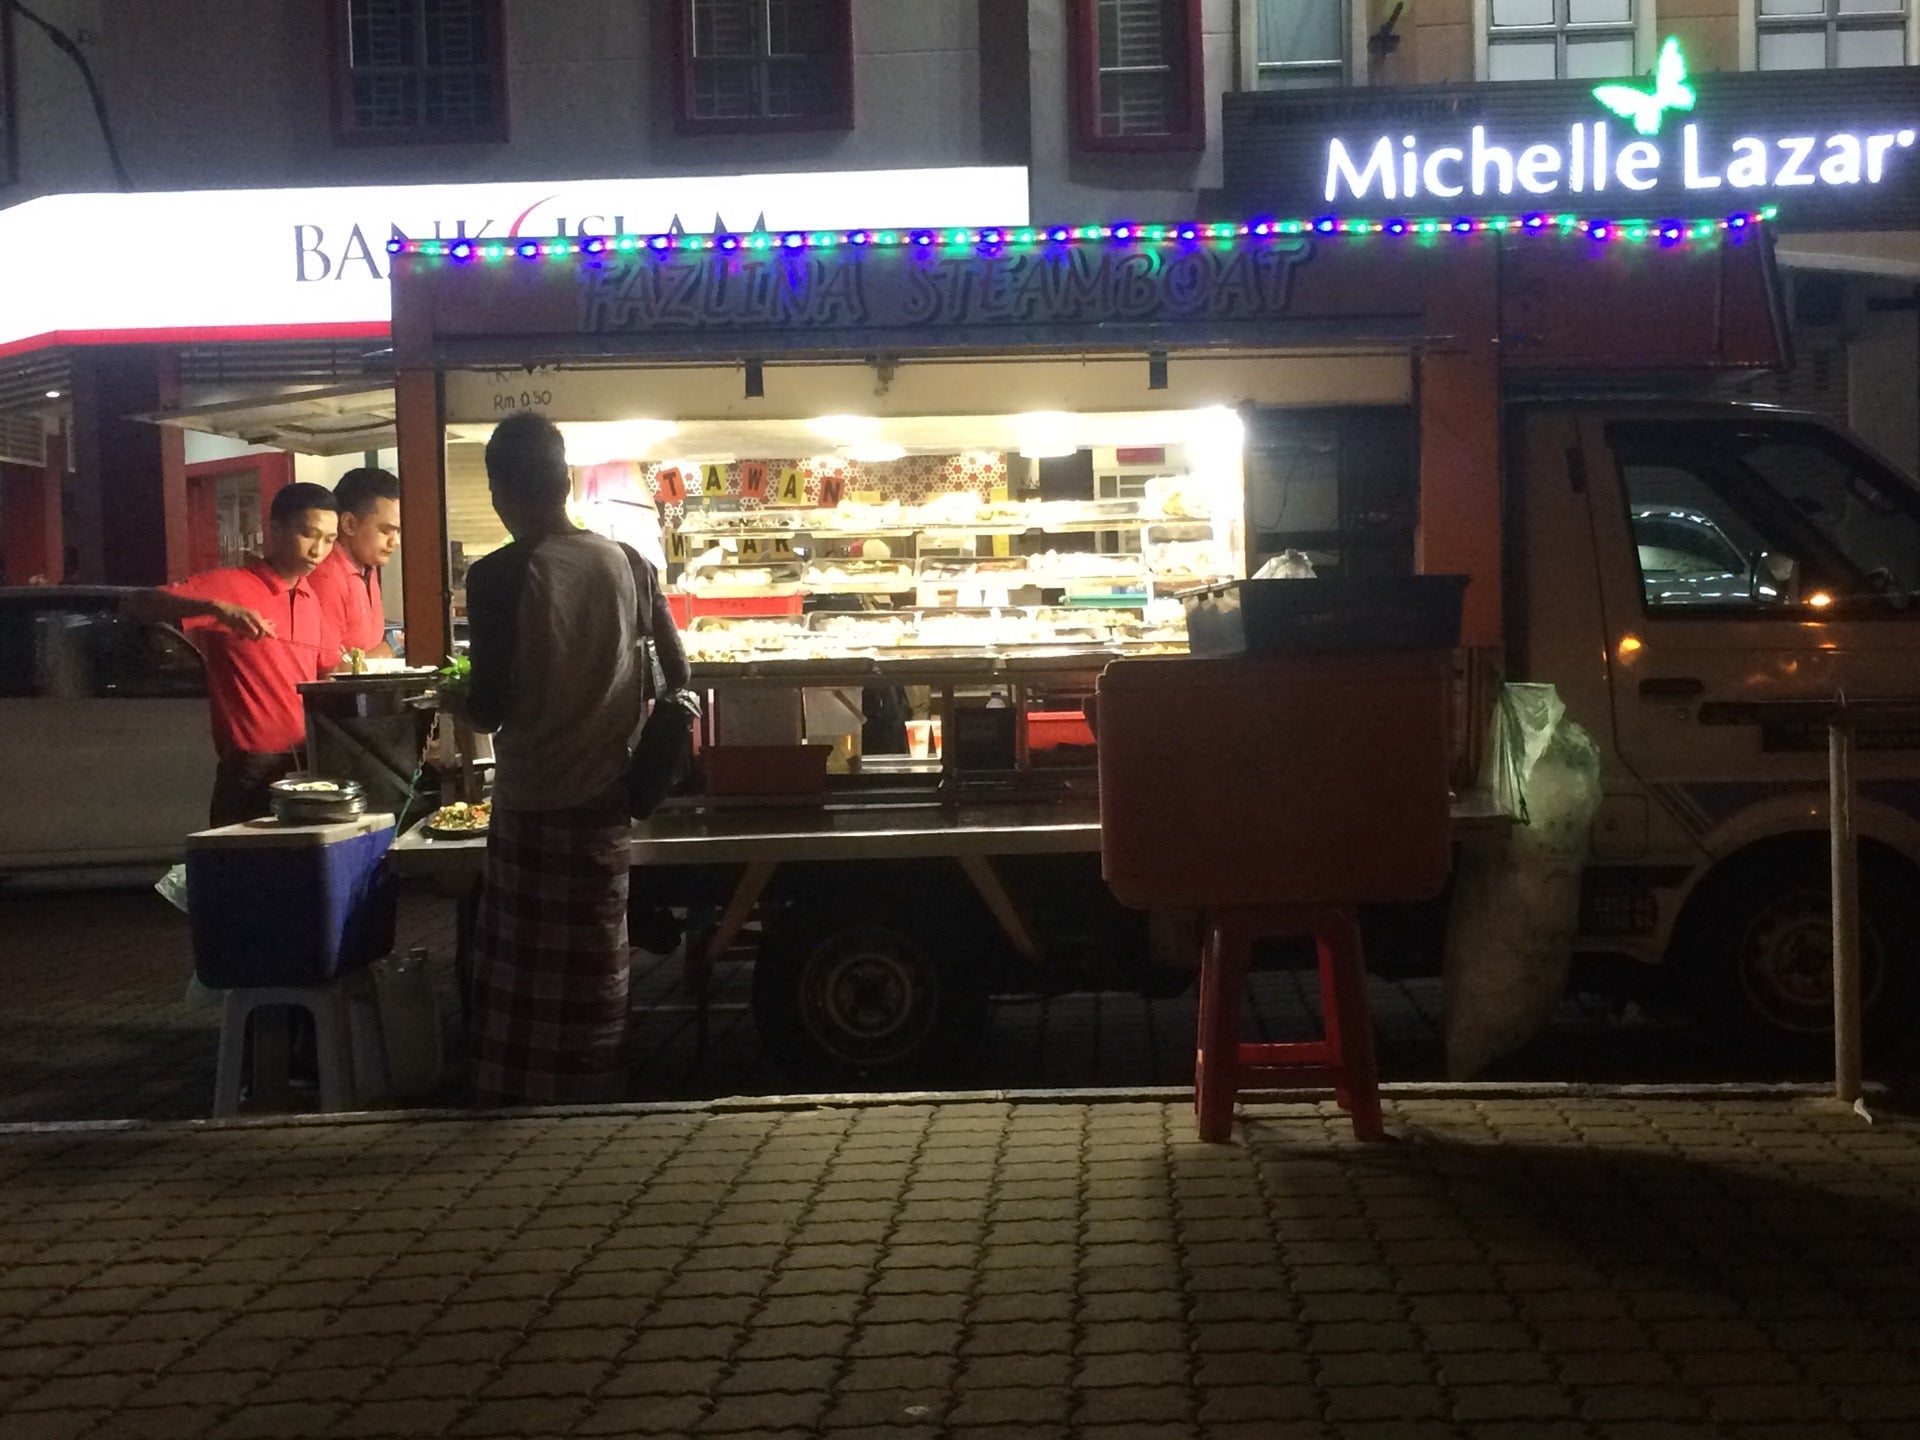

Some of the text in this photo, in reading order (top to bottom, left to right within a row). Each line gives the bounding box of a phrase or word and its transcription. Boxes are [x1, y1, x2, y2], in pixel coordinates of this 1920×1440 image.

[1324, 121, 1898, 202] Michelle Lazar
[293, 218, 495, 282] BA
[901, 238, 1316, 325] STEAMBOAT
